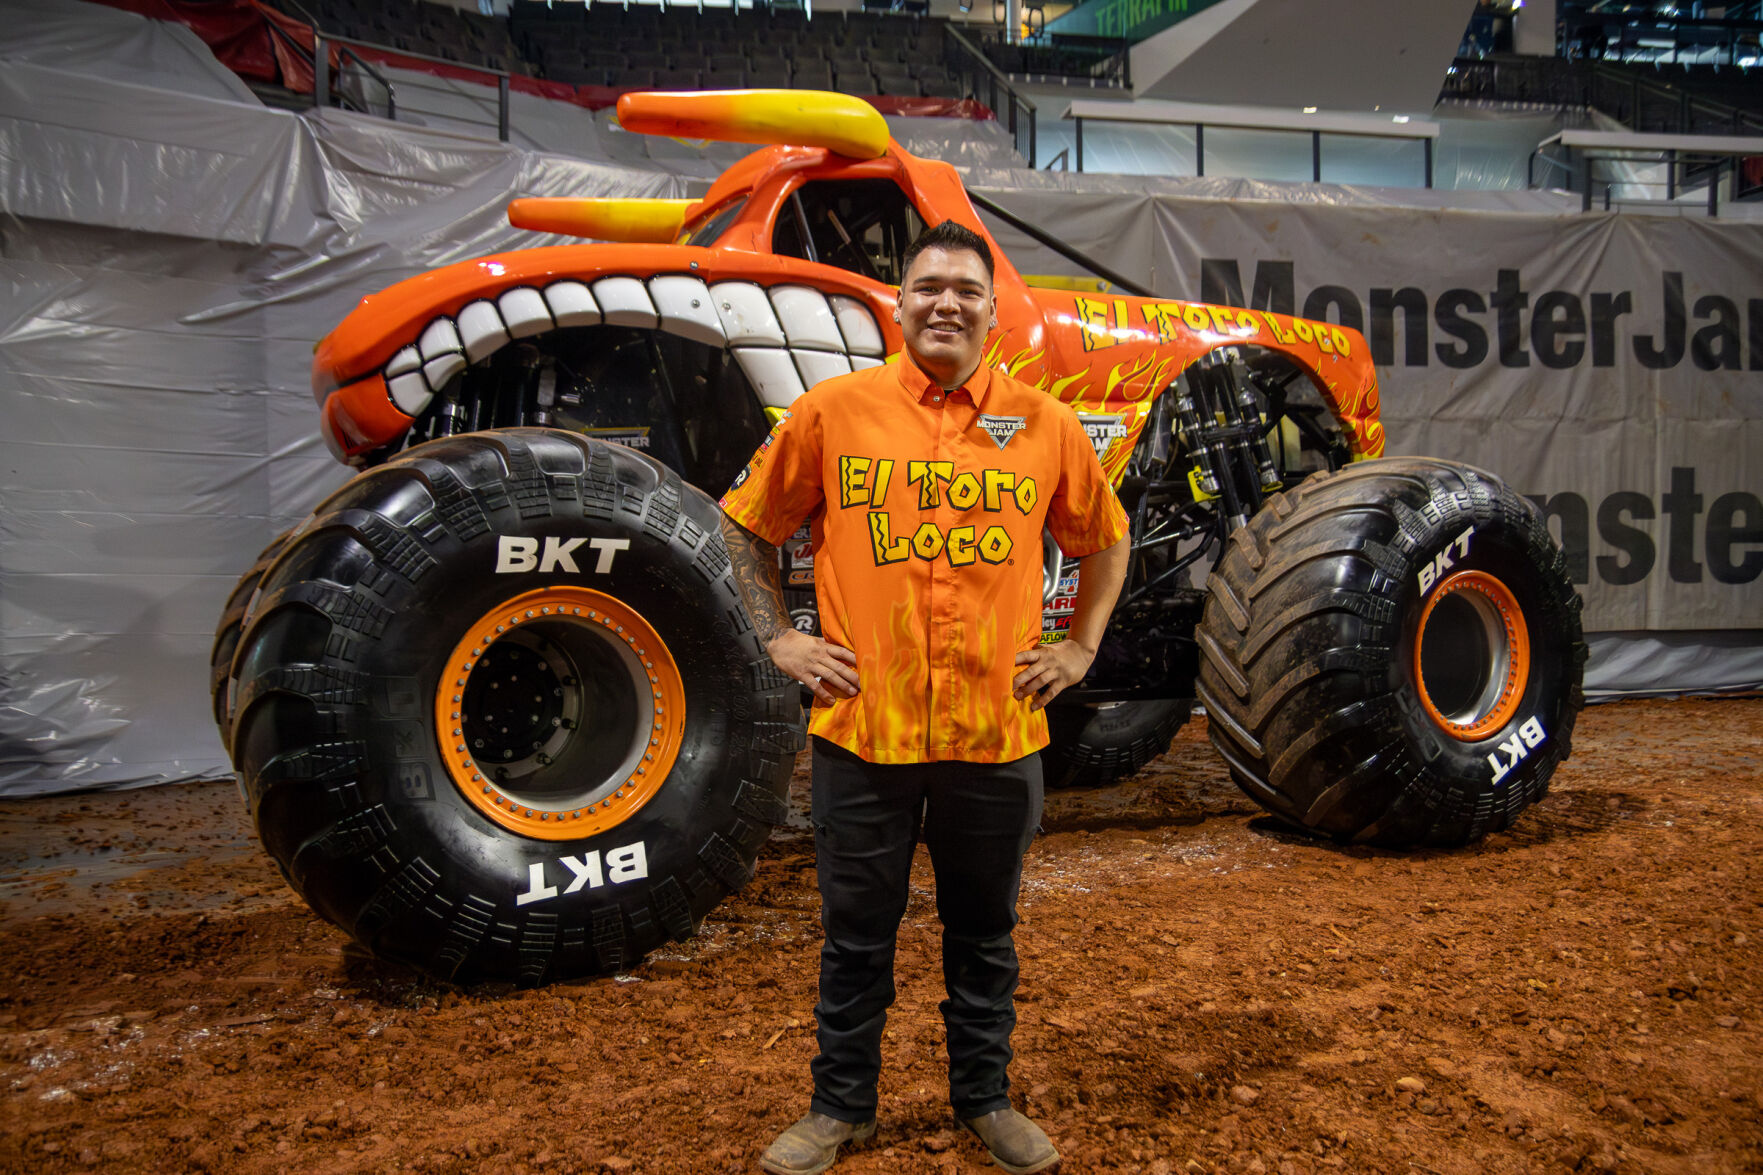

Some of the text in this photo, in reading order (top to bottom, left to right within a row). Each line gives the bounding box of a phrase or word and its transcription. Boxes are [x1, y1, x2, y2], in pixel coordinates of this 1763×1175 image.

[1200, 259, 1763, 372] MonsterJa
[976, 420, 1026, 430] MONSTER
[495, 535, 630, 574] BKT
[1417, 527, 1475, 597] BKT
[1486, 715, 1547, 785] BKT
[516, 840, 649, 906] BKT
